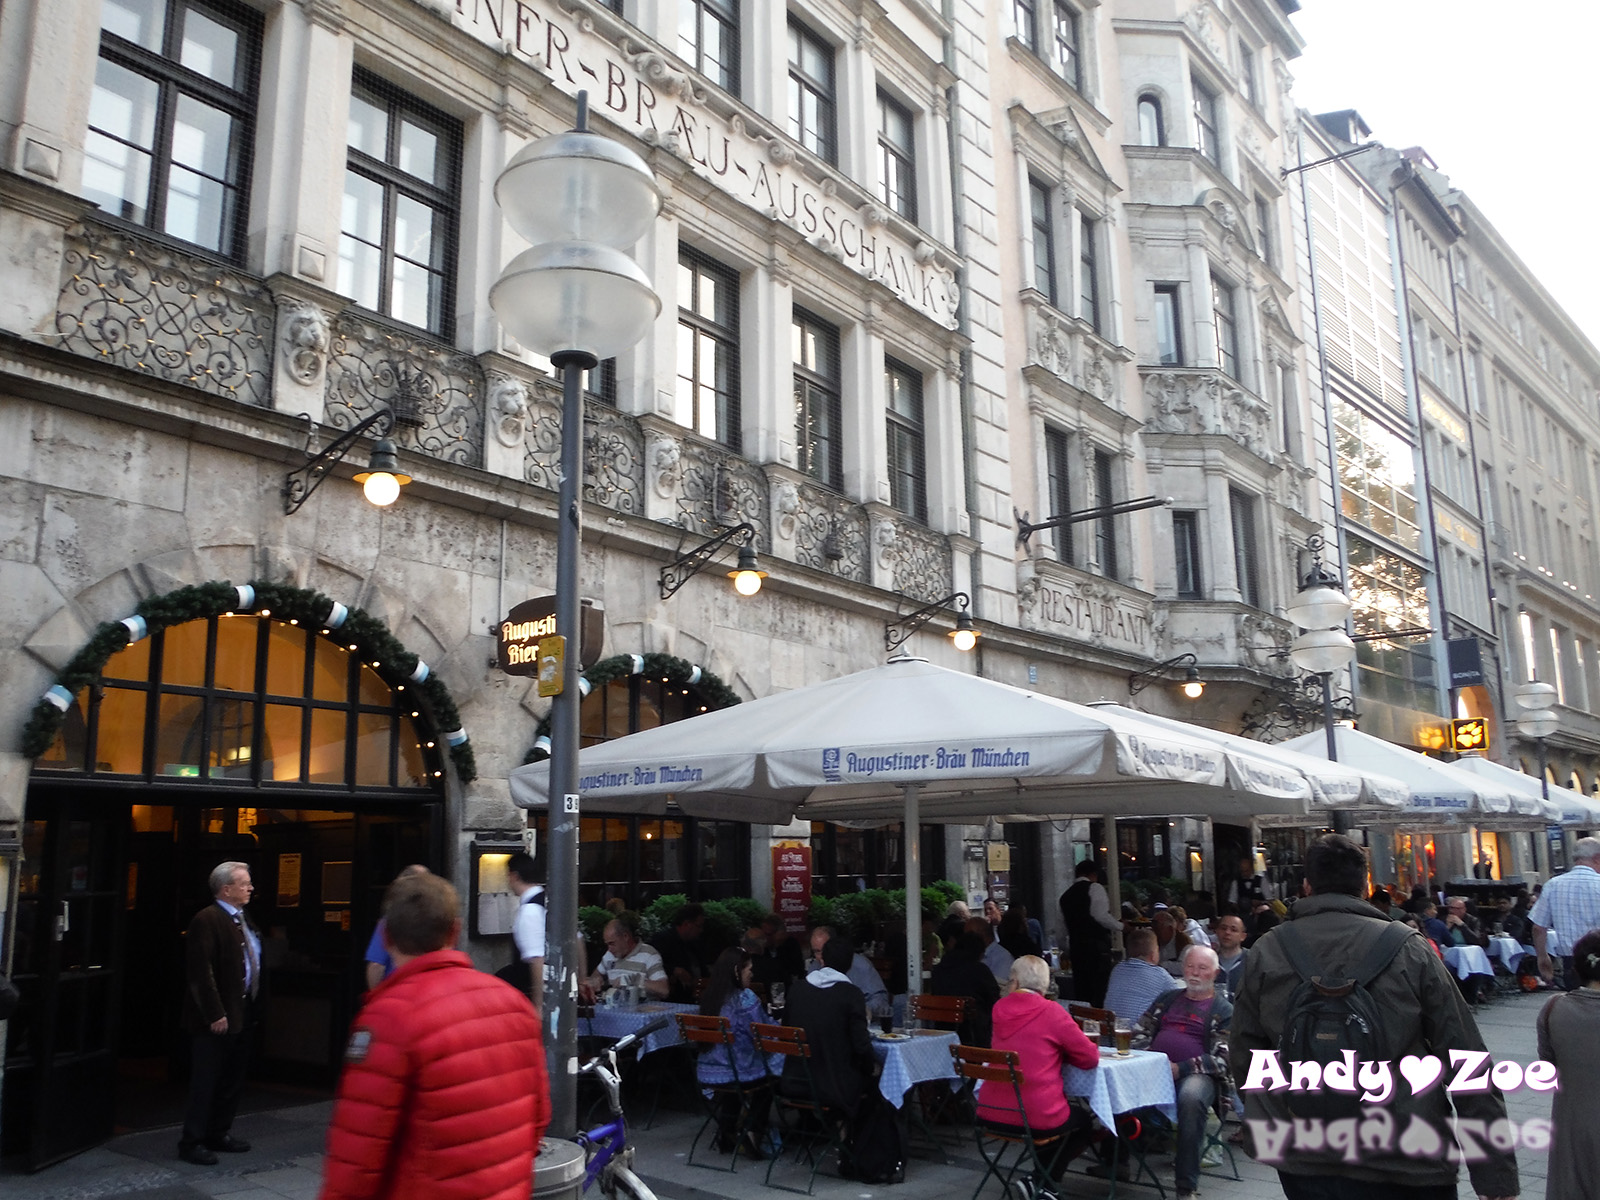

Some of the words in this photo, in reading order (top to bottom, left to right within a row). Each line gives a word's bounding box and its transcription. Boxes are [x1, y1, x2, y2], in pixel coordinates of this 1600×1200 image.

[502, 613, 557, 642] Augusti
[1040, 587, 1147, 645] RESTAURANT
[507, 643, 540, 665] Bier
[971, 747, 1030, 768] München
